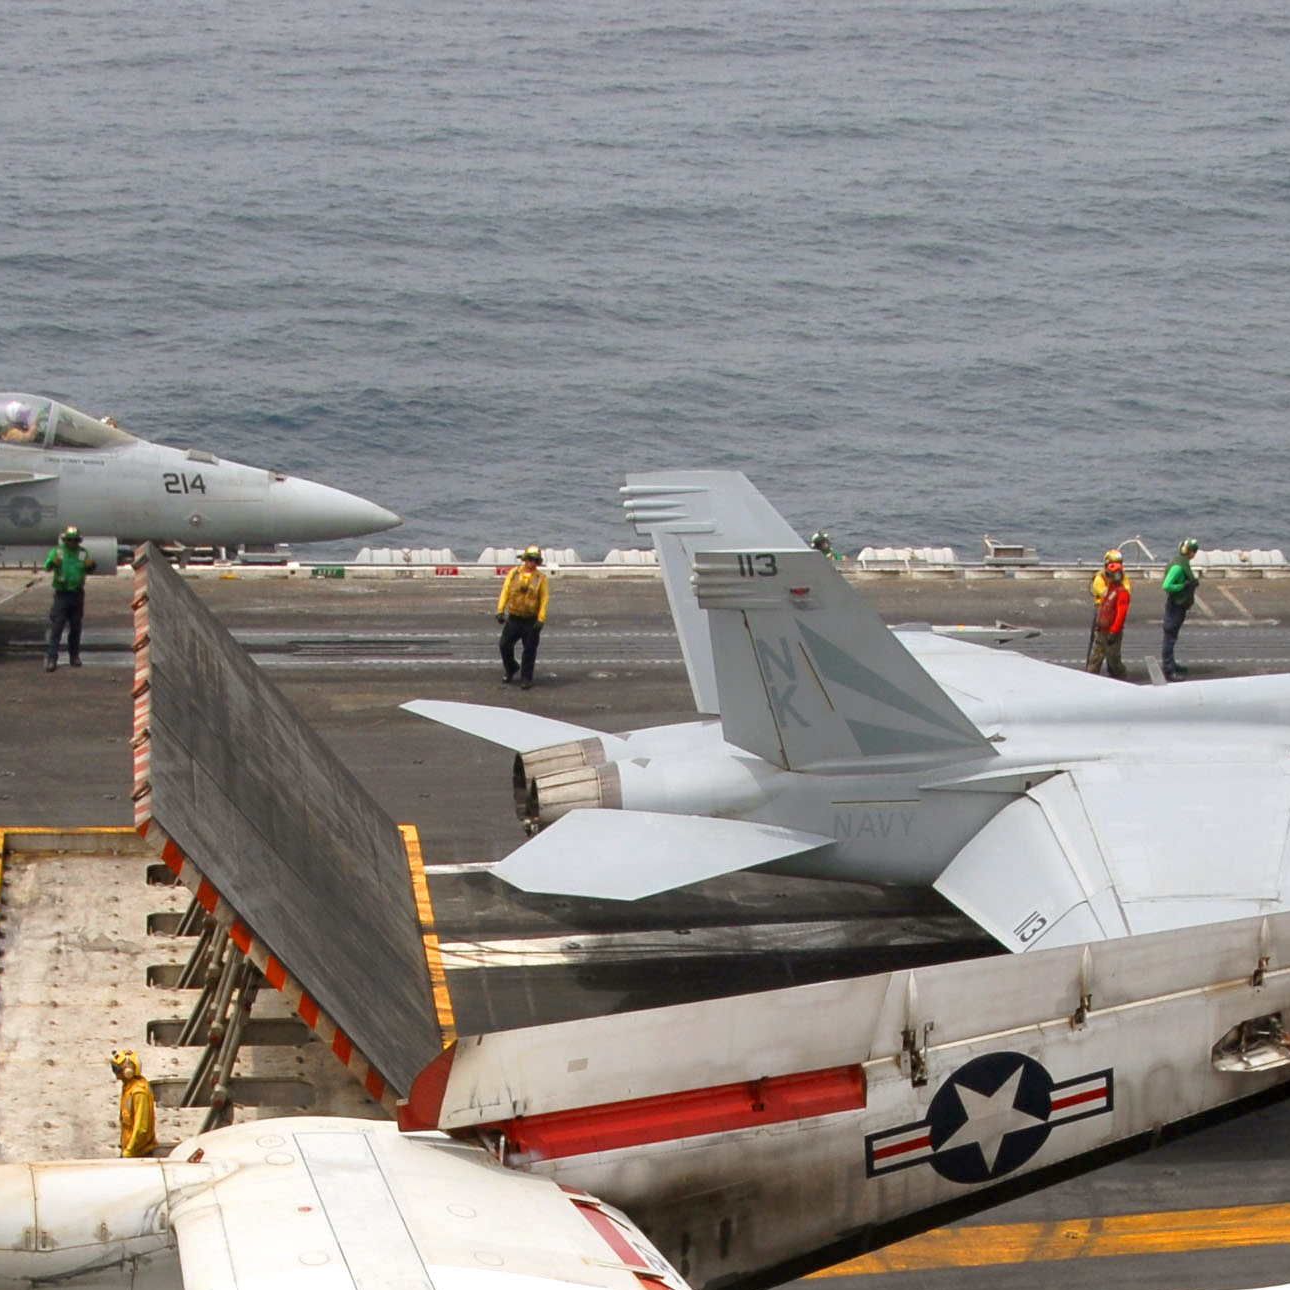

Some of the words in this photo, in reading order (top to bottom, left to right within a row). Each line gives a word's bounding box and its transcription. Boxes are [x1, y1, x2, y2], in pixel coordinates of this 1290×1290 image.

[163, 473, 206, 494] 214
[737, 553, 778, 577] 113
[832, 811, 917, 839] NAVY
[1013, 910, 1048, 943] 113
